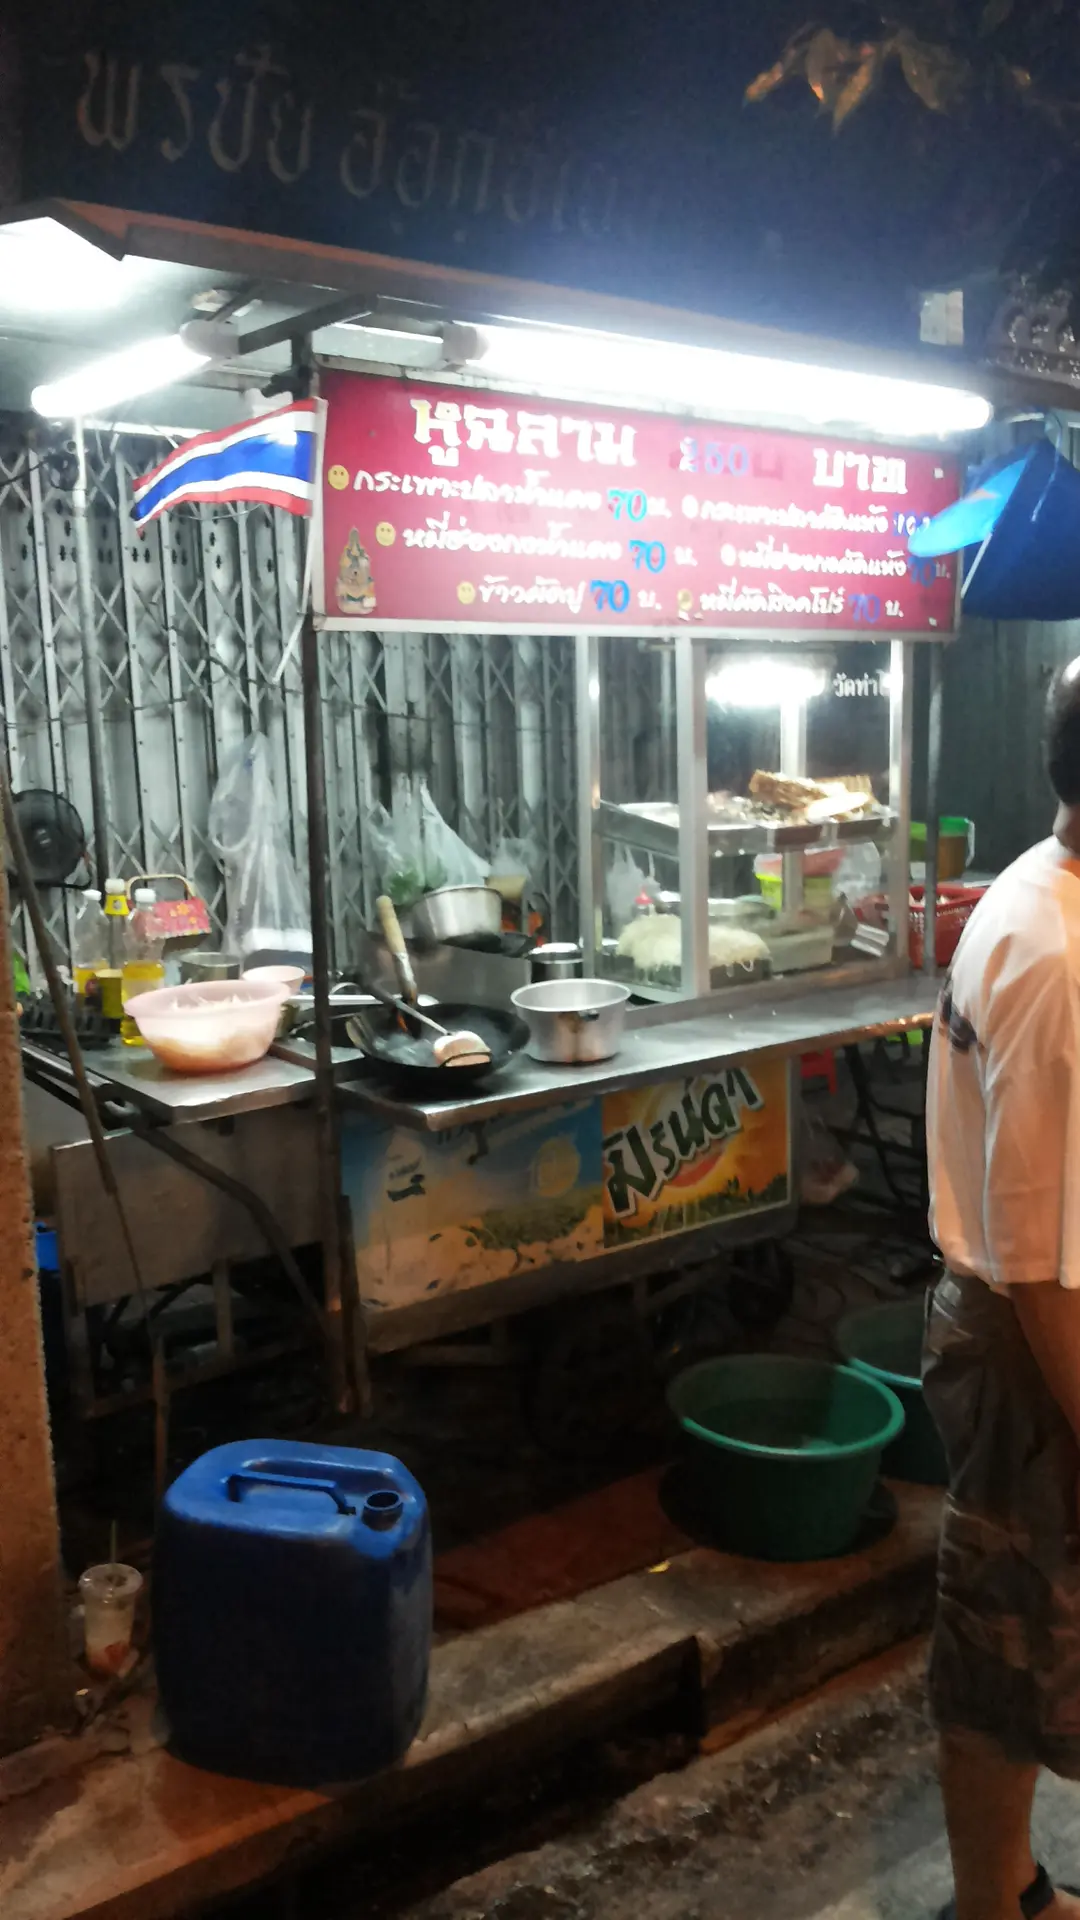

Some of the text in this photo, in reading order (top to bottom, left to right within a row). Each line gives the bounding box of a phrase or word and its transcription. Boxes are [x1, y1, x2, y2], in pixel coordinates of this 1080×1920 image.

[409, 398, 638, 467] หูฉลาม
[812, 447, 908, 495] บาท
[607, 489, 647, 522] 70
[629, 539, 667, 574] 70
[906, 556, 936, 588] 70
[479, 575, 586, 614] ข้าวผัดปู
[589, 579, 630, 613] 70
[847, 593, 882, 624] 70
